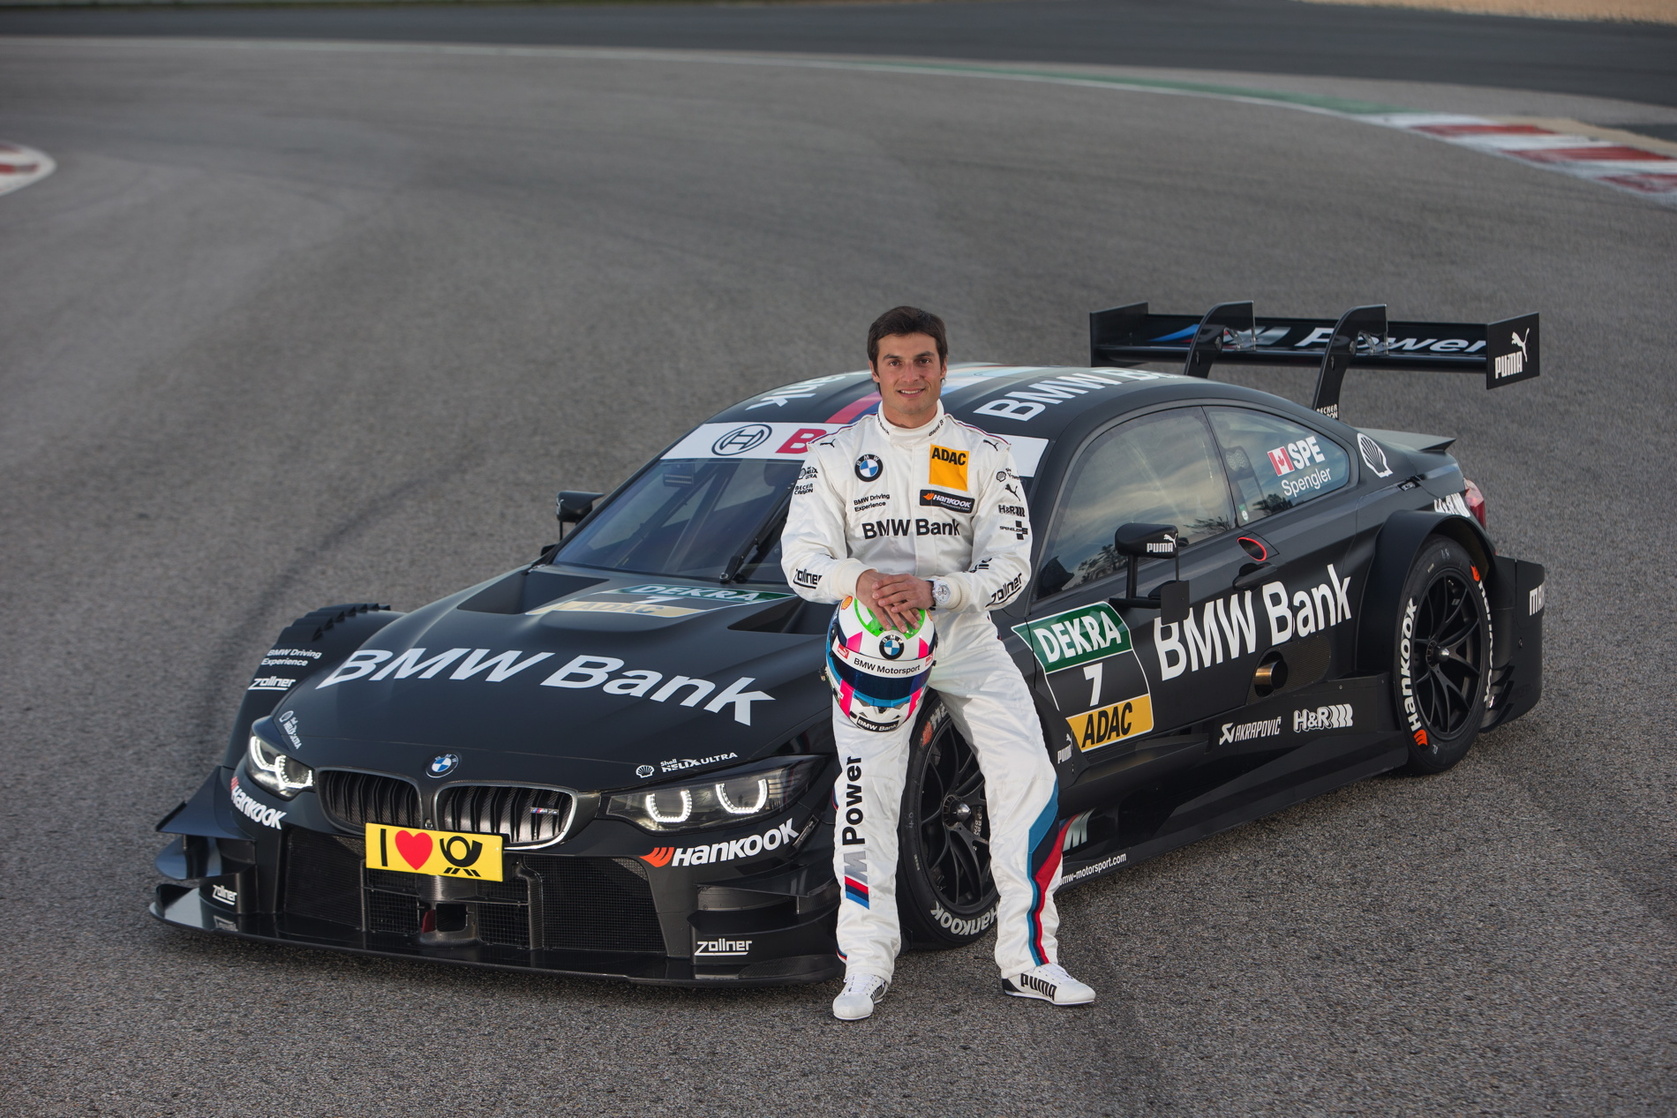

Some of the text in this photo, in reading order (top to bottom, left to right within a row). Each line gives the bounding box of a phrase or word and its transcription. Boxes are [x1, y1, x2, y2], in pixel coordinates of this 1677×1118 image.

[1495, 351, 1523, 379] PUMA
[973, 372, 1122, 421] BMW
[931, 447, 967, 466] ADAC
[1287, 436, 1325, 470] SPE
[1281, 467, 1332, 497] Spengler
[853, 493, 891, 505] BMW Driving
[854, 501, 887, 512] Experience
[862, 518, 961, 540] BMW Bank
[1146, 543, 1174, 553] PUMA
[634, 585, 760, 600] DEKRA
[1153, 564, 1352, 682] BMW Bank
[1033, 611, 1122, 663] DEKRA
[261, 658, 309, 666] Experience
[290, 649, 322, 659] Driving
[854, 658, 921, 675] BMW Motorsport
[315, 648, 776, 727] BMW Bank
[1083, 662, 1103, 707] 7
[857, 718, 899, 732] BMW Bank
[1081, 702, 1133, 749] ADAC
[660, 758, 677, 767] Shell
[700, 752, 738, 764] ULTRA
[842, 756, 865, 846] Power
[1020, 973, 1057, 1001] PUMA
